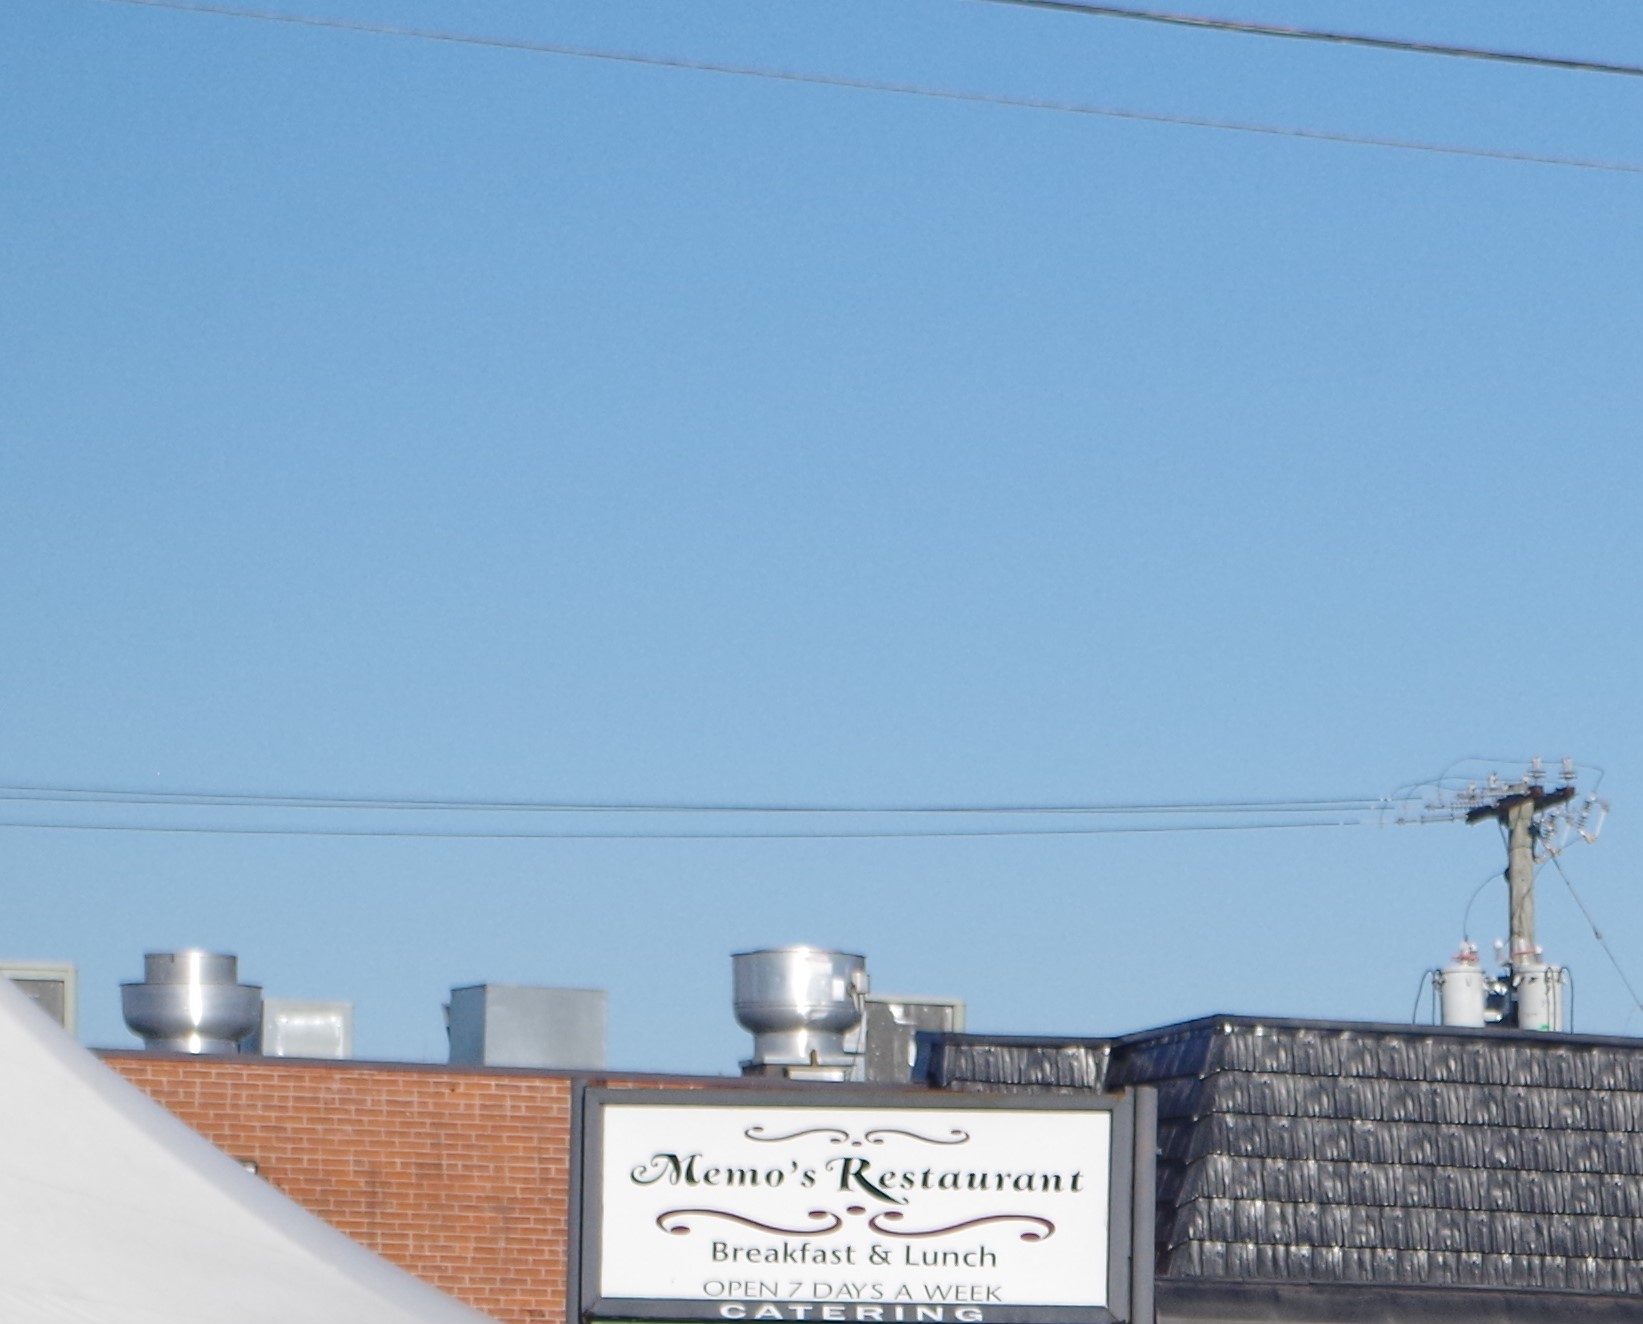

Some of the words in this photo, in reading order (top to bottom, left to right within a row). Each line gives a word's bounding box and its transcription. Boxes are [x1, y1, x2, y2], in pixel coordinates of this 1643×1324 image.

[630, 1152, 816, 1188] Memo's
[825, 1156, 1084, 1205] Restaurant
[712, 1241, 856, 1267] Breakfast
[869, 1244, 892, 1265] &
[905, 1245, 998, 1269] Lunch
[703, 1280, 779, 1298] OPEN
[789, 1281, 805, 1299] 7
[813, 1282, 884, 1300] DAYS
[895, 1284, 914, 1301] A
[924, 1284, 1003, 1303] WEEK
[719, 1305, 984, 1323] CATERING
